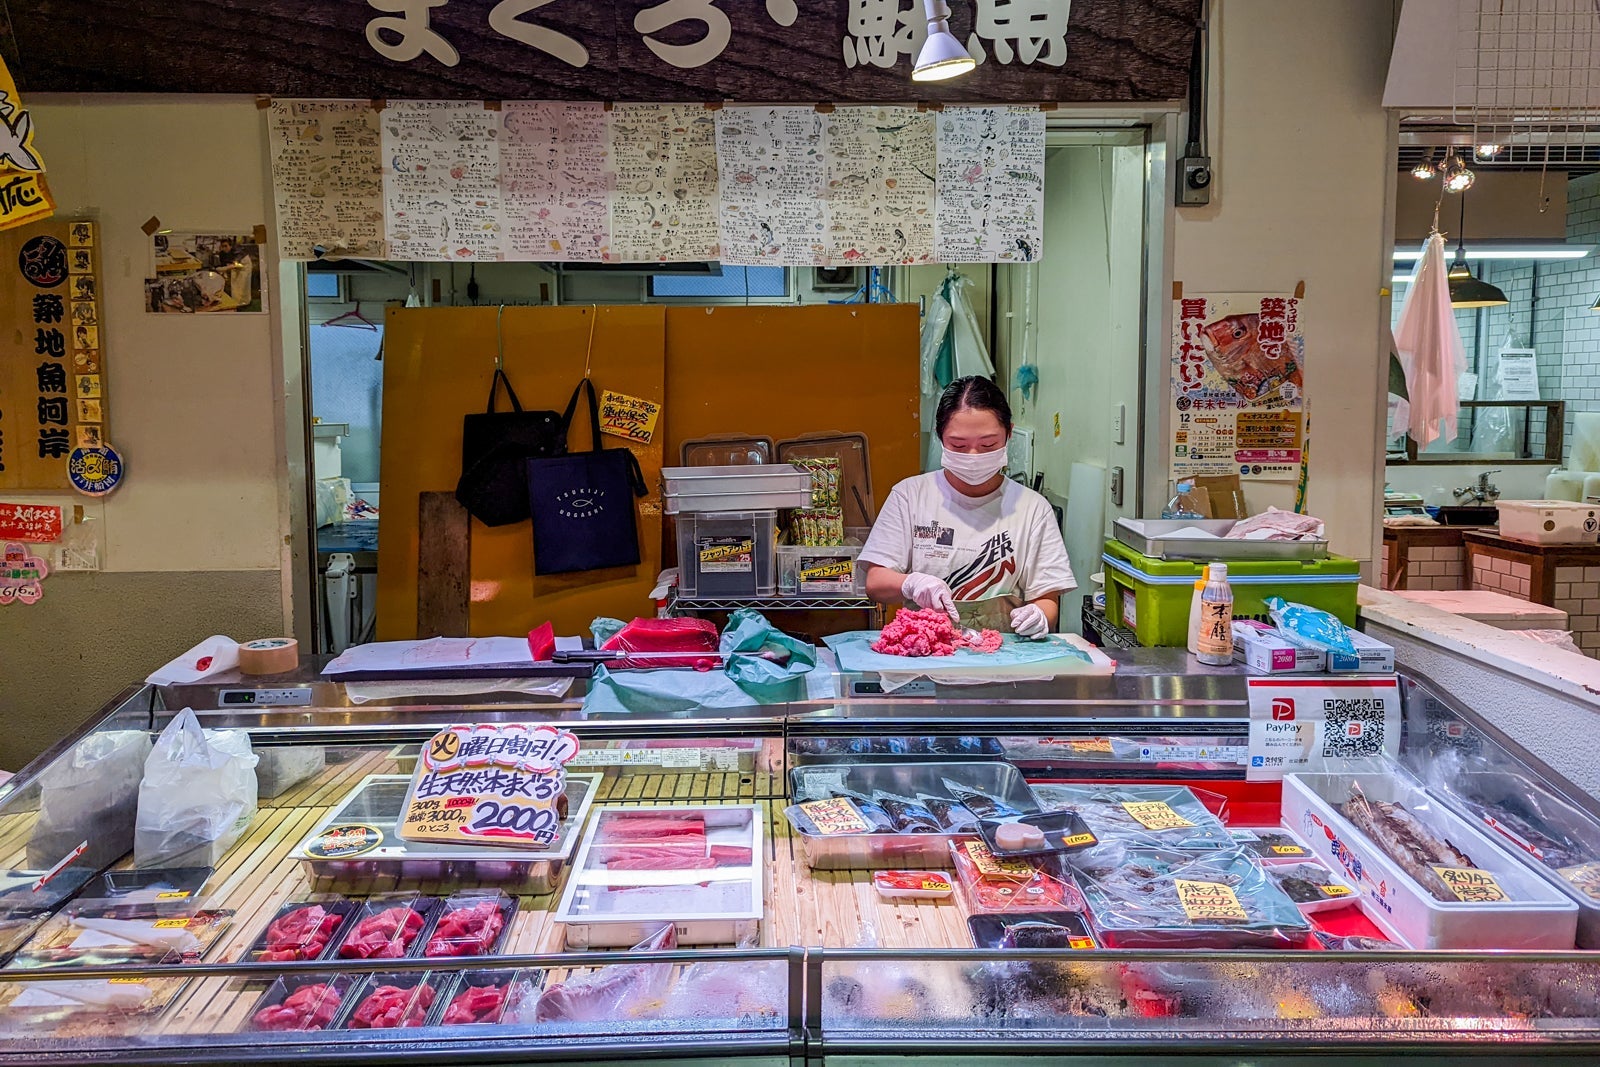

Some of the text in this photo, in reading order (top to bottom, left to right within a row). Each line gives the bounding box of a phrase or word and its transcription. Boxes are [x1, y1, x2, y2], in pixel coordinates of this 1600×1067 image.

[1286, 299, 1298, 333] やっぱり
[1259, 297, 1286, 358] 築地で
[32, 293, 70, 459] 築地魚河岸
[1192, 399, 1248, 411] 年末セール
[1180, 413, 1191, 423] 12
[556, 488, 606, 501] TSUKIJI
[739, 553, 751, 562] 25
[1266, 723, 1302, 733] PayPay
[417, 770, 560, 799] 生天然本まぐろ
